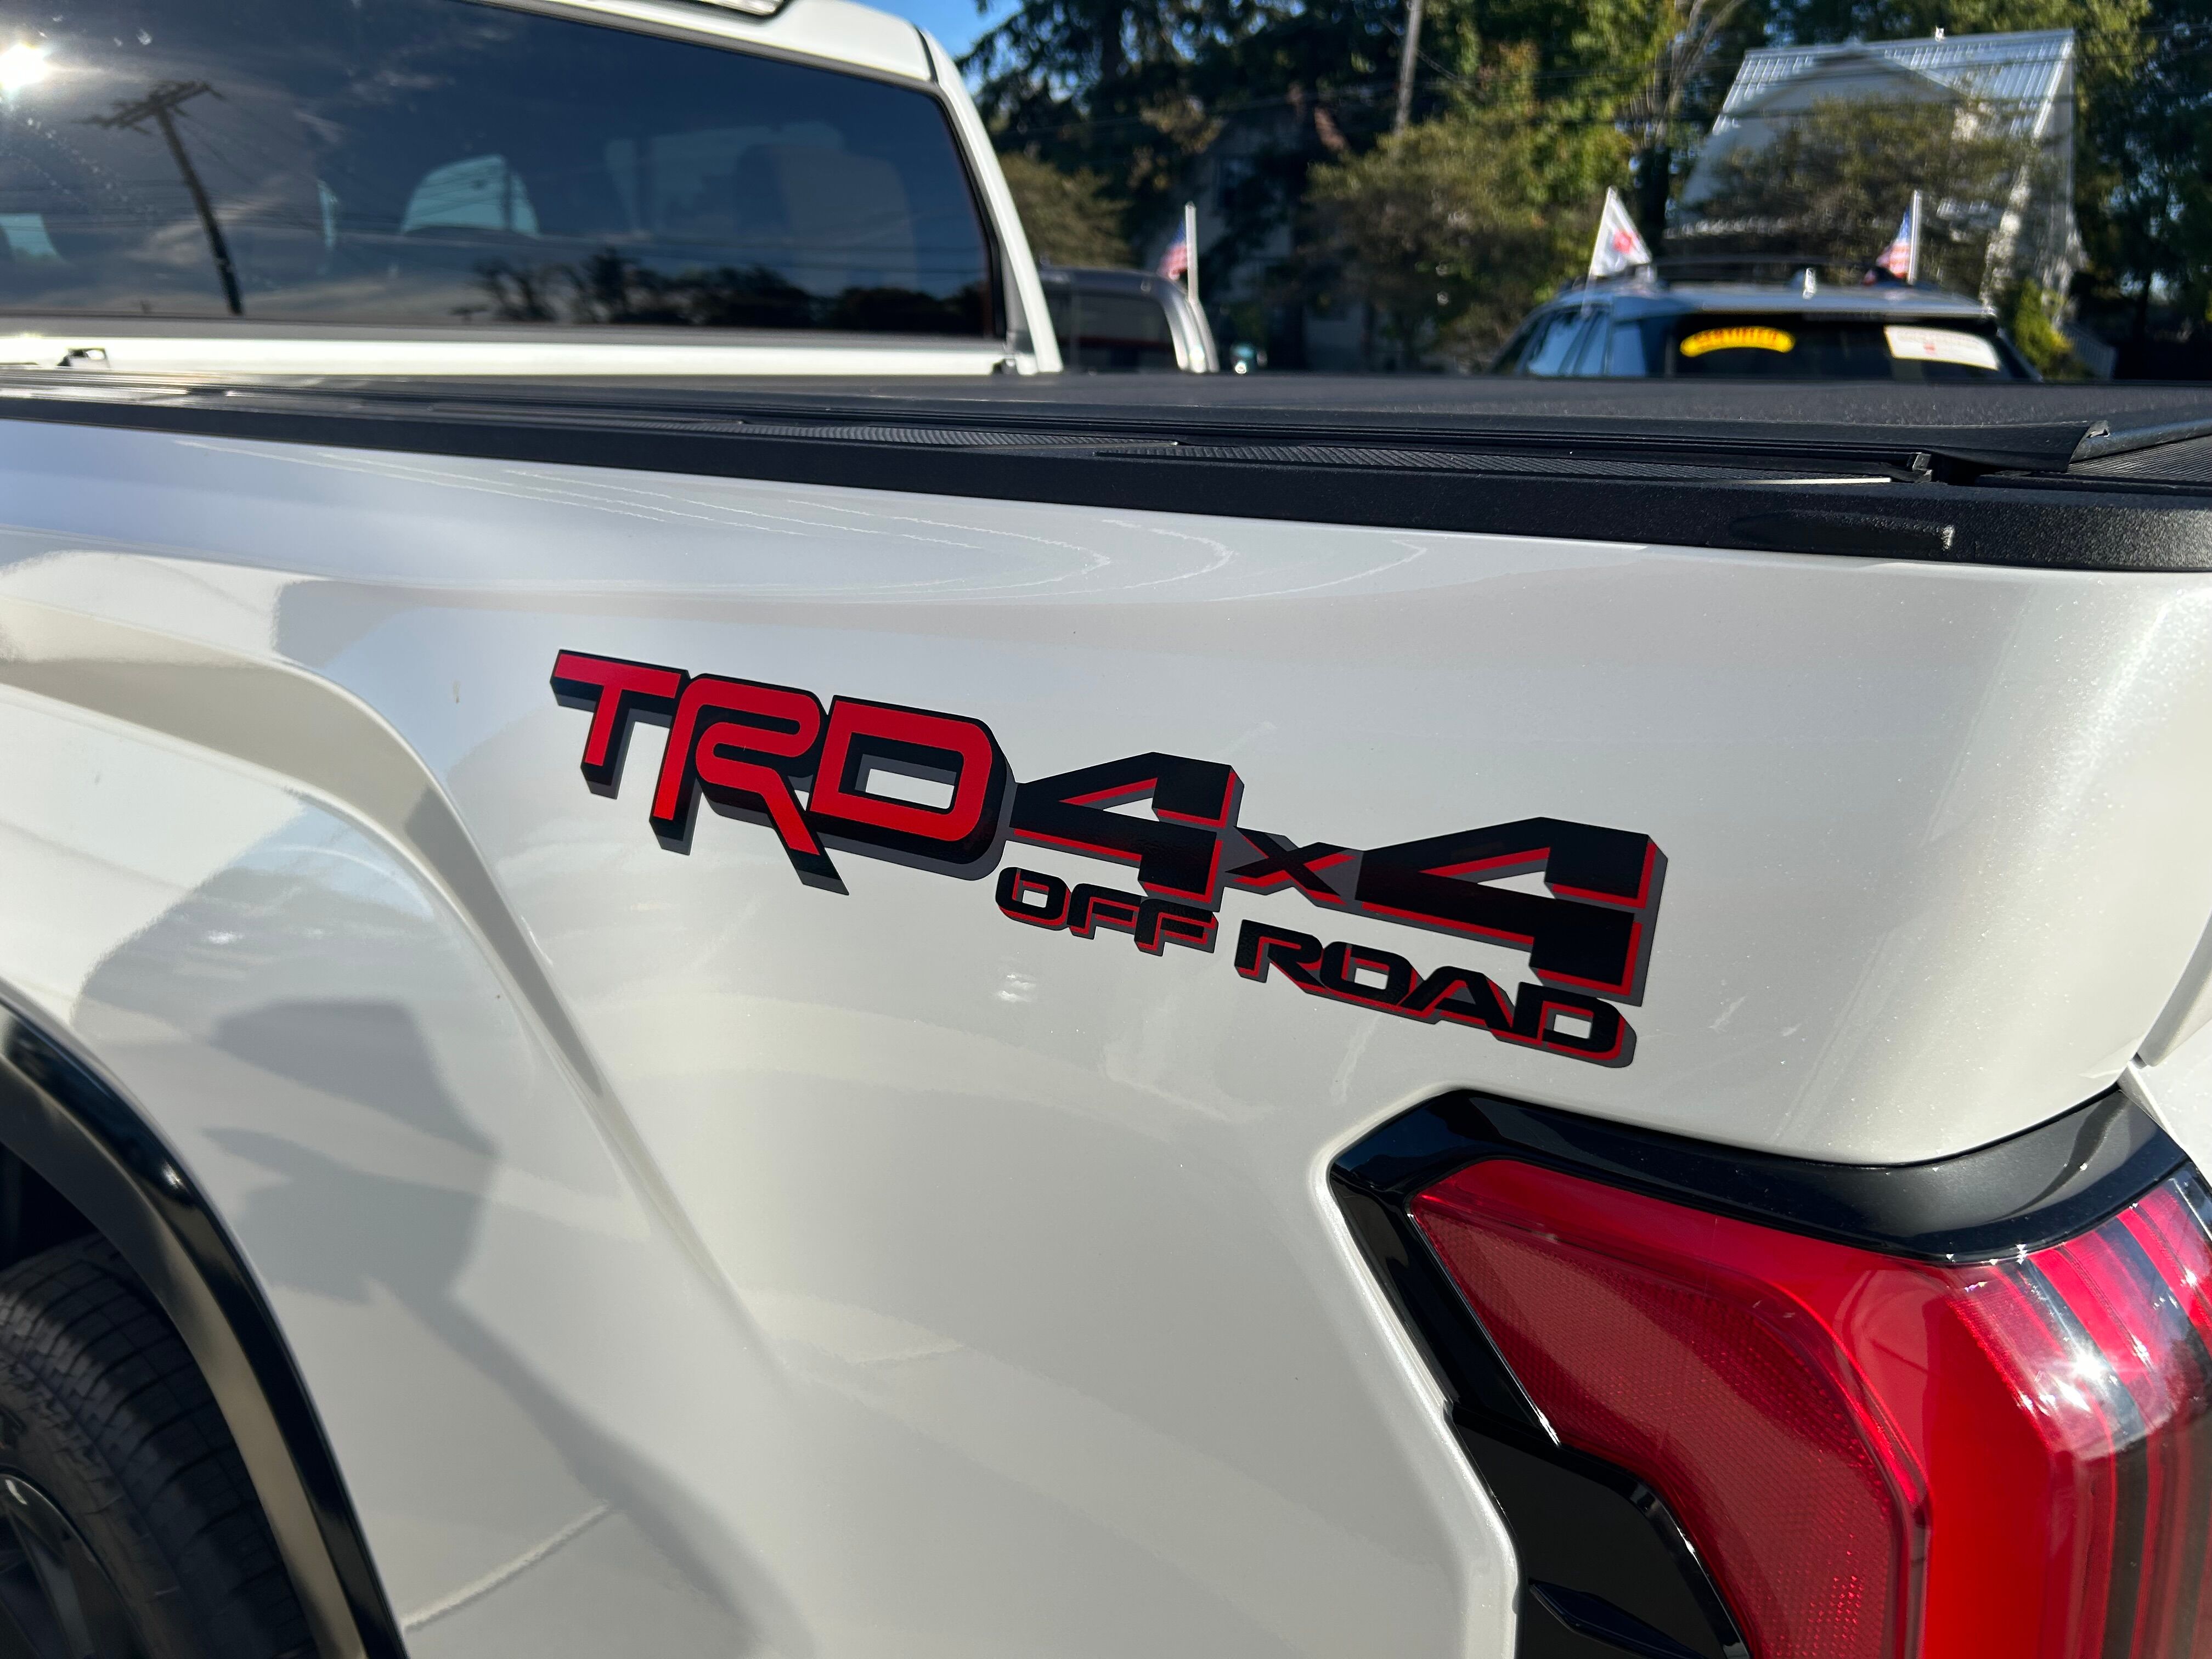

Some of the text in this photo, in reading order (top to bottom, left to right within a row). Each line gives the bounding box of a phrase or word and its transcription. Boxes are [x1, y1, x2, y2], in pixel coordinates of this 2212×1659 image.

[550, 650, 1013, 895] TRD
[995, 867, 1638, 1068] OFF ROAD
